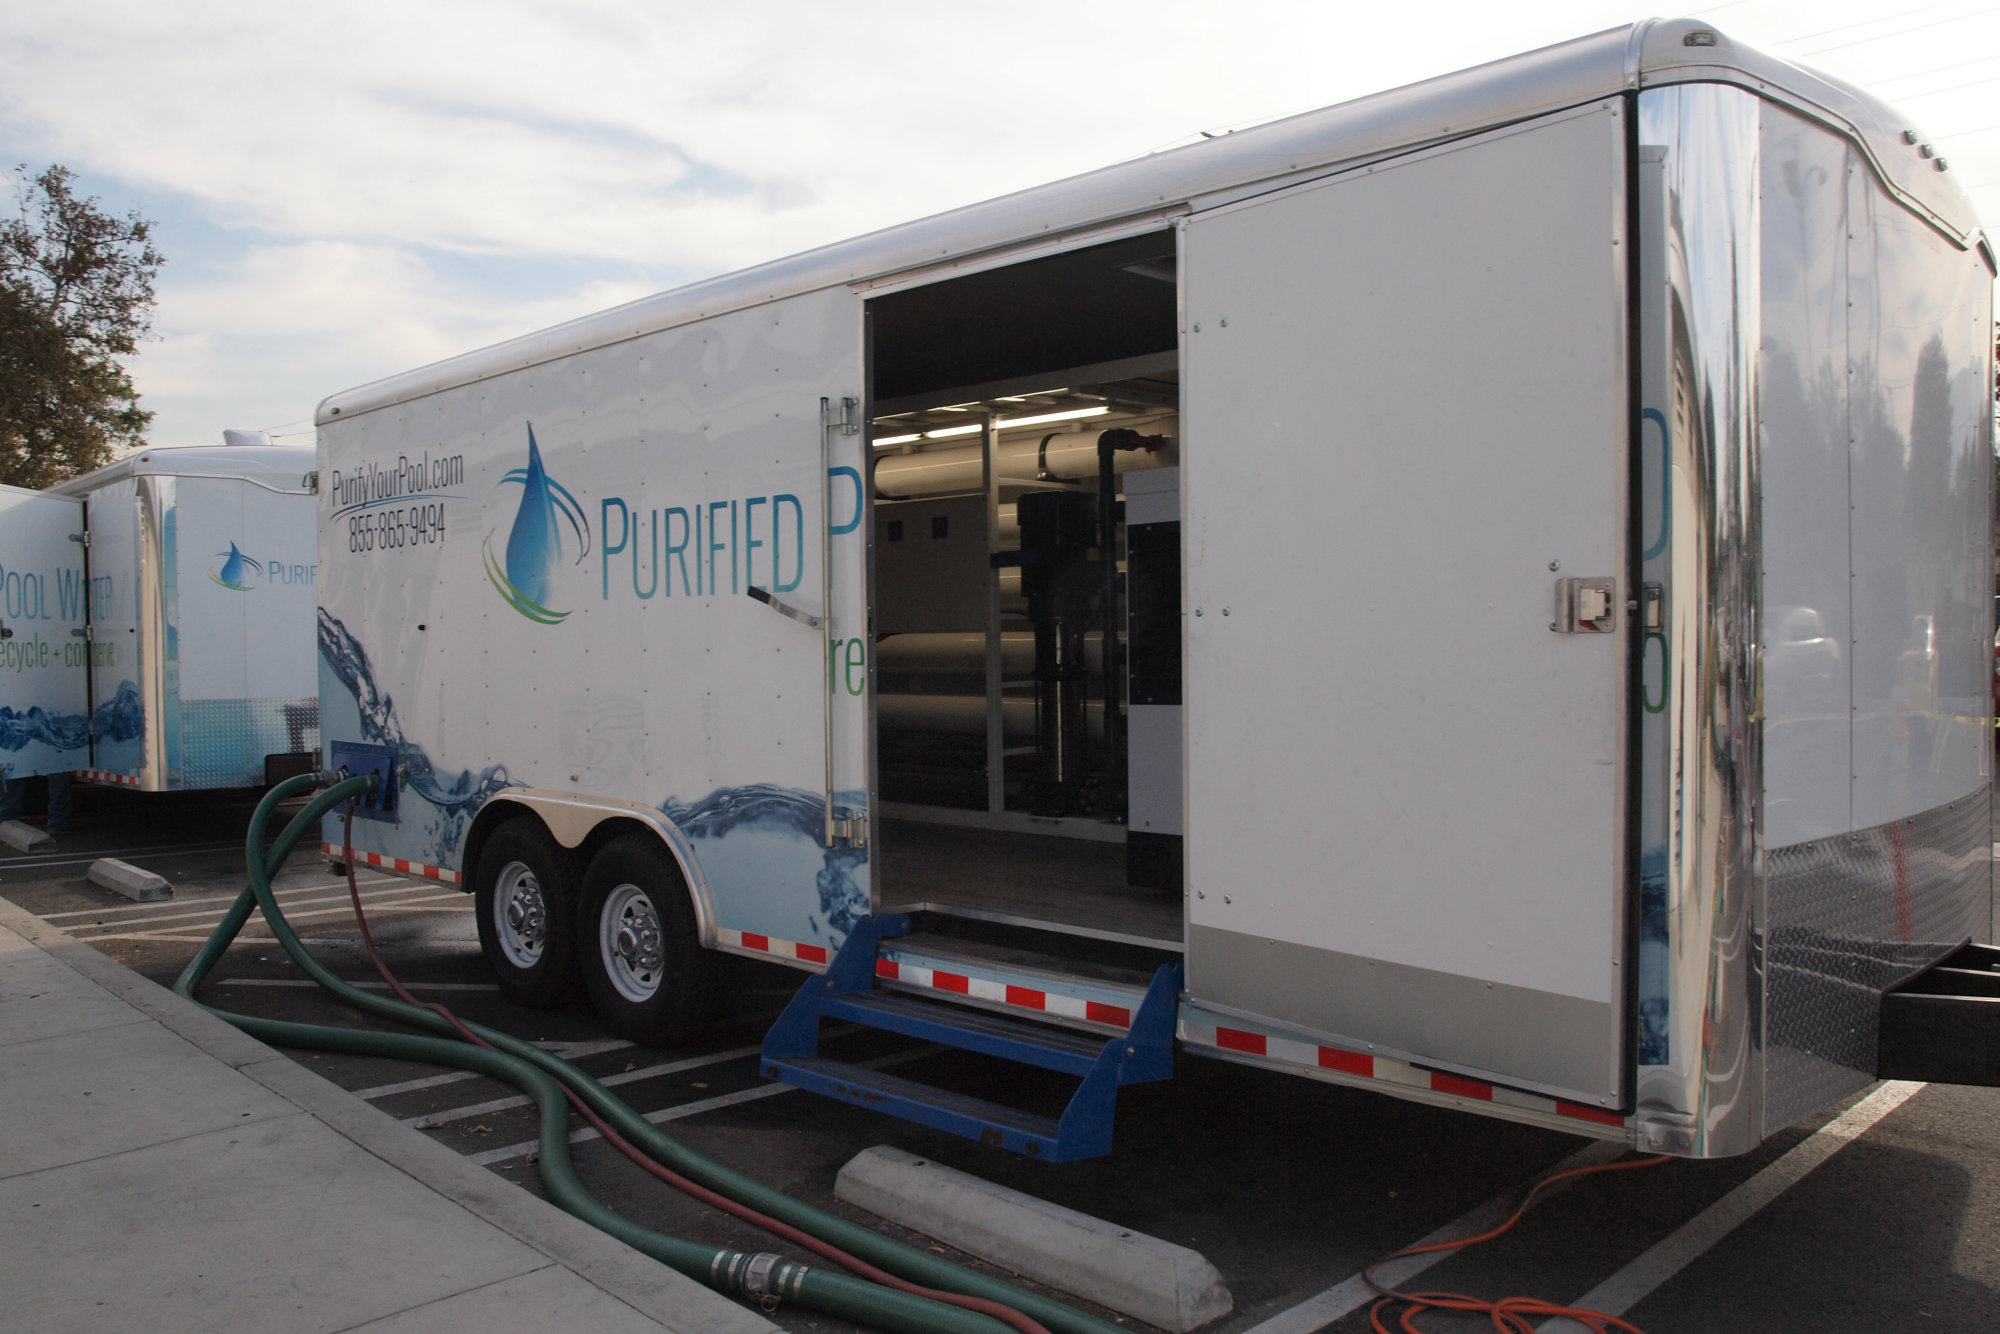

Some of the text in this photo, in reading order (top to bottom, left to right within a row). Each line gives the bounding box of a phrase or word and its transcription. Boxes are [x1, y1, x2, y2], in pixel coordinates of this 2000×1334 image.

[332, 450, 464, 508] PurifyYourPool.com
[348, 502, 446, 553] 855-865-9494
[601, 493, 804, 601] PURIFIED
[0, 562, 52, 620] OOL
